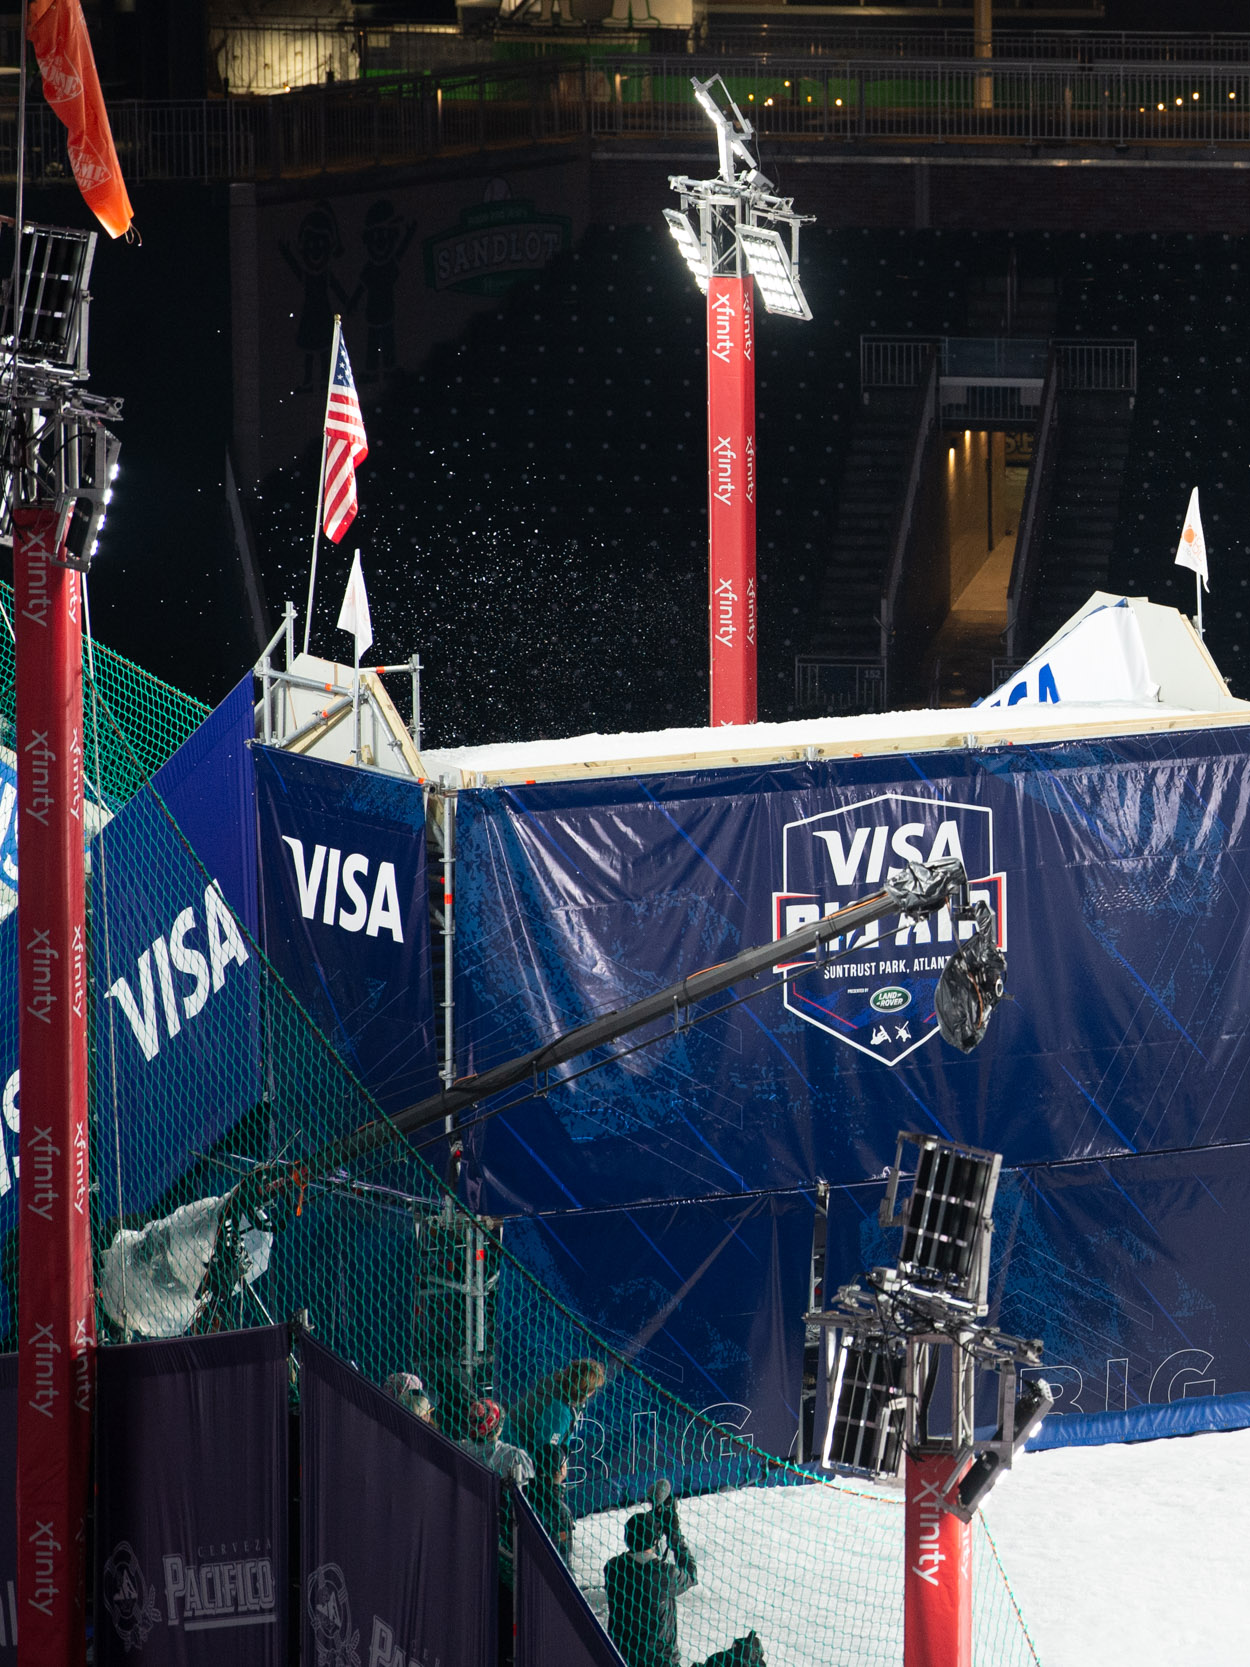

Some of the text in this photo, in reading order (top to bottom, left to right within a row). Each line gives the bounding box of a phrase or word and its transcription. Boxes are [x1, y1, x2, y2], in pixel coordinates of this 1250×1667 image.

[438, 231, 559, 281] SANDLOT
[712, 292, 735, 363] xfinity
[713, 436, 736, 505] xfinity
[20, 530, 53, 627] xfinity
[68, 568, 82, 624] nity
[715, 578, 737, 647] xfinity
[25, 728, 56, 826] xfinity
[70, 727, 81, 820] xfinity
[282, 835, 404, 943] VISA
[813, 820, 965, 886] VISA
[27, 927, 59, 1024] xfinity
[72, 923, 84, 1018] xfinity
[104, 878, 249, 1062] VISA
[824, 956, 952, 979] SUNTRUST PARK, ATLANT
[878, 992, 898, 1000] LAND
[880, 998, 904, 1007] ROVER
[27, 1126, 60, 1221] xfinity
[74, 1121, 86, 1215] xfinity
[28, 1322, 62, 1418] xfinity
[74, 1317, 94, 1412] xfinity
[28, 1520, 62, 1616] xfinity
[198, 1538, 272, 1558] CERVEZA
[912, 1479, 946, 1586] xfinity
[162, 1553, 276, 1627] PACIFICO
